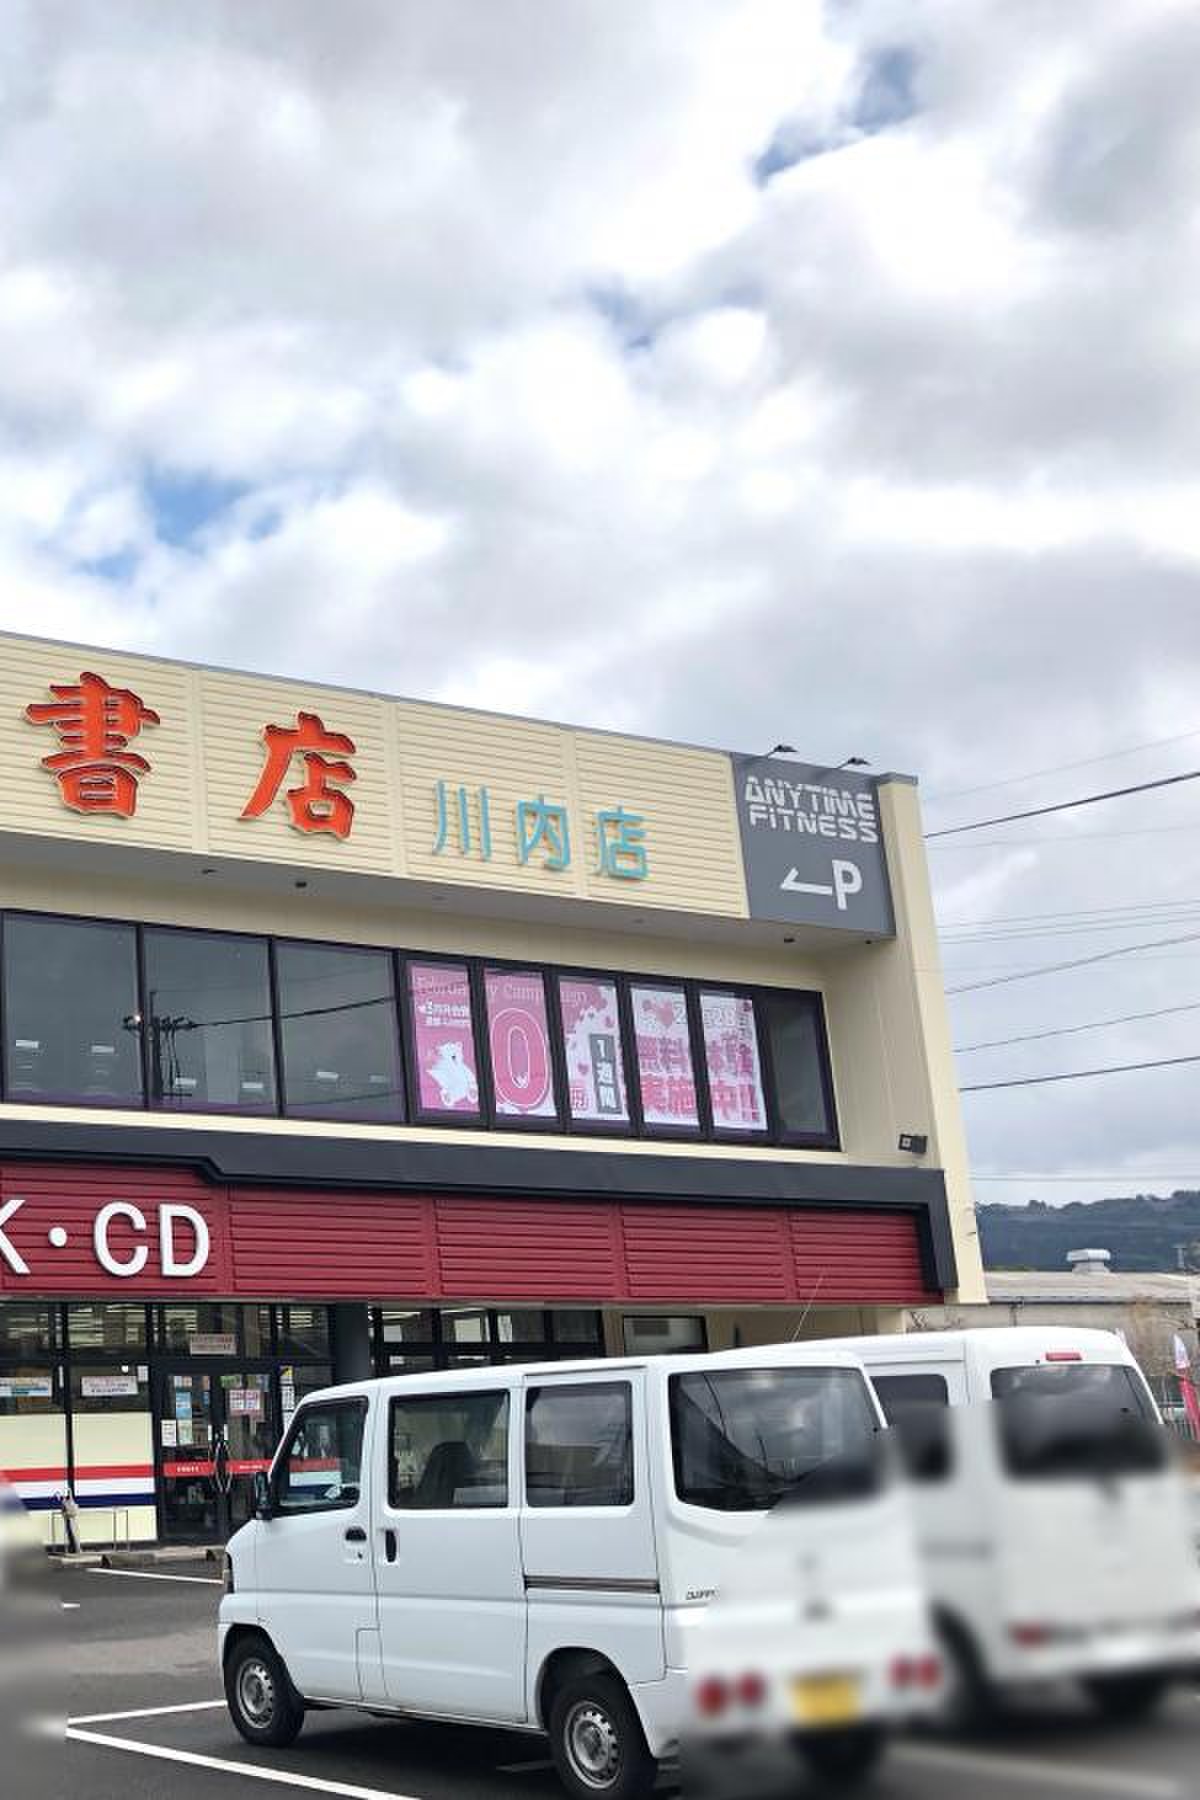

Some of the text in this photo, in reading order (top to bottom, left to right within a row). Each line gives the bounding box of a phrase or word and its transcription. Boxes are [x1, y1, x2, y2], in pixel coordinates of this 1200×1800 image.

[745, 776, 876, 821] ANYTIME
[432, 779, 649, 879] 川内店
[749, 804, 879, 843] FITNESS
[832, 859, 863, 911] P
